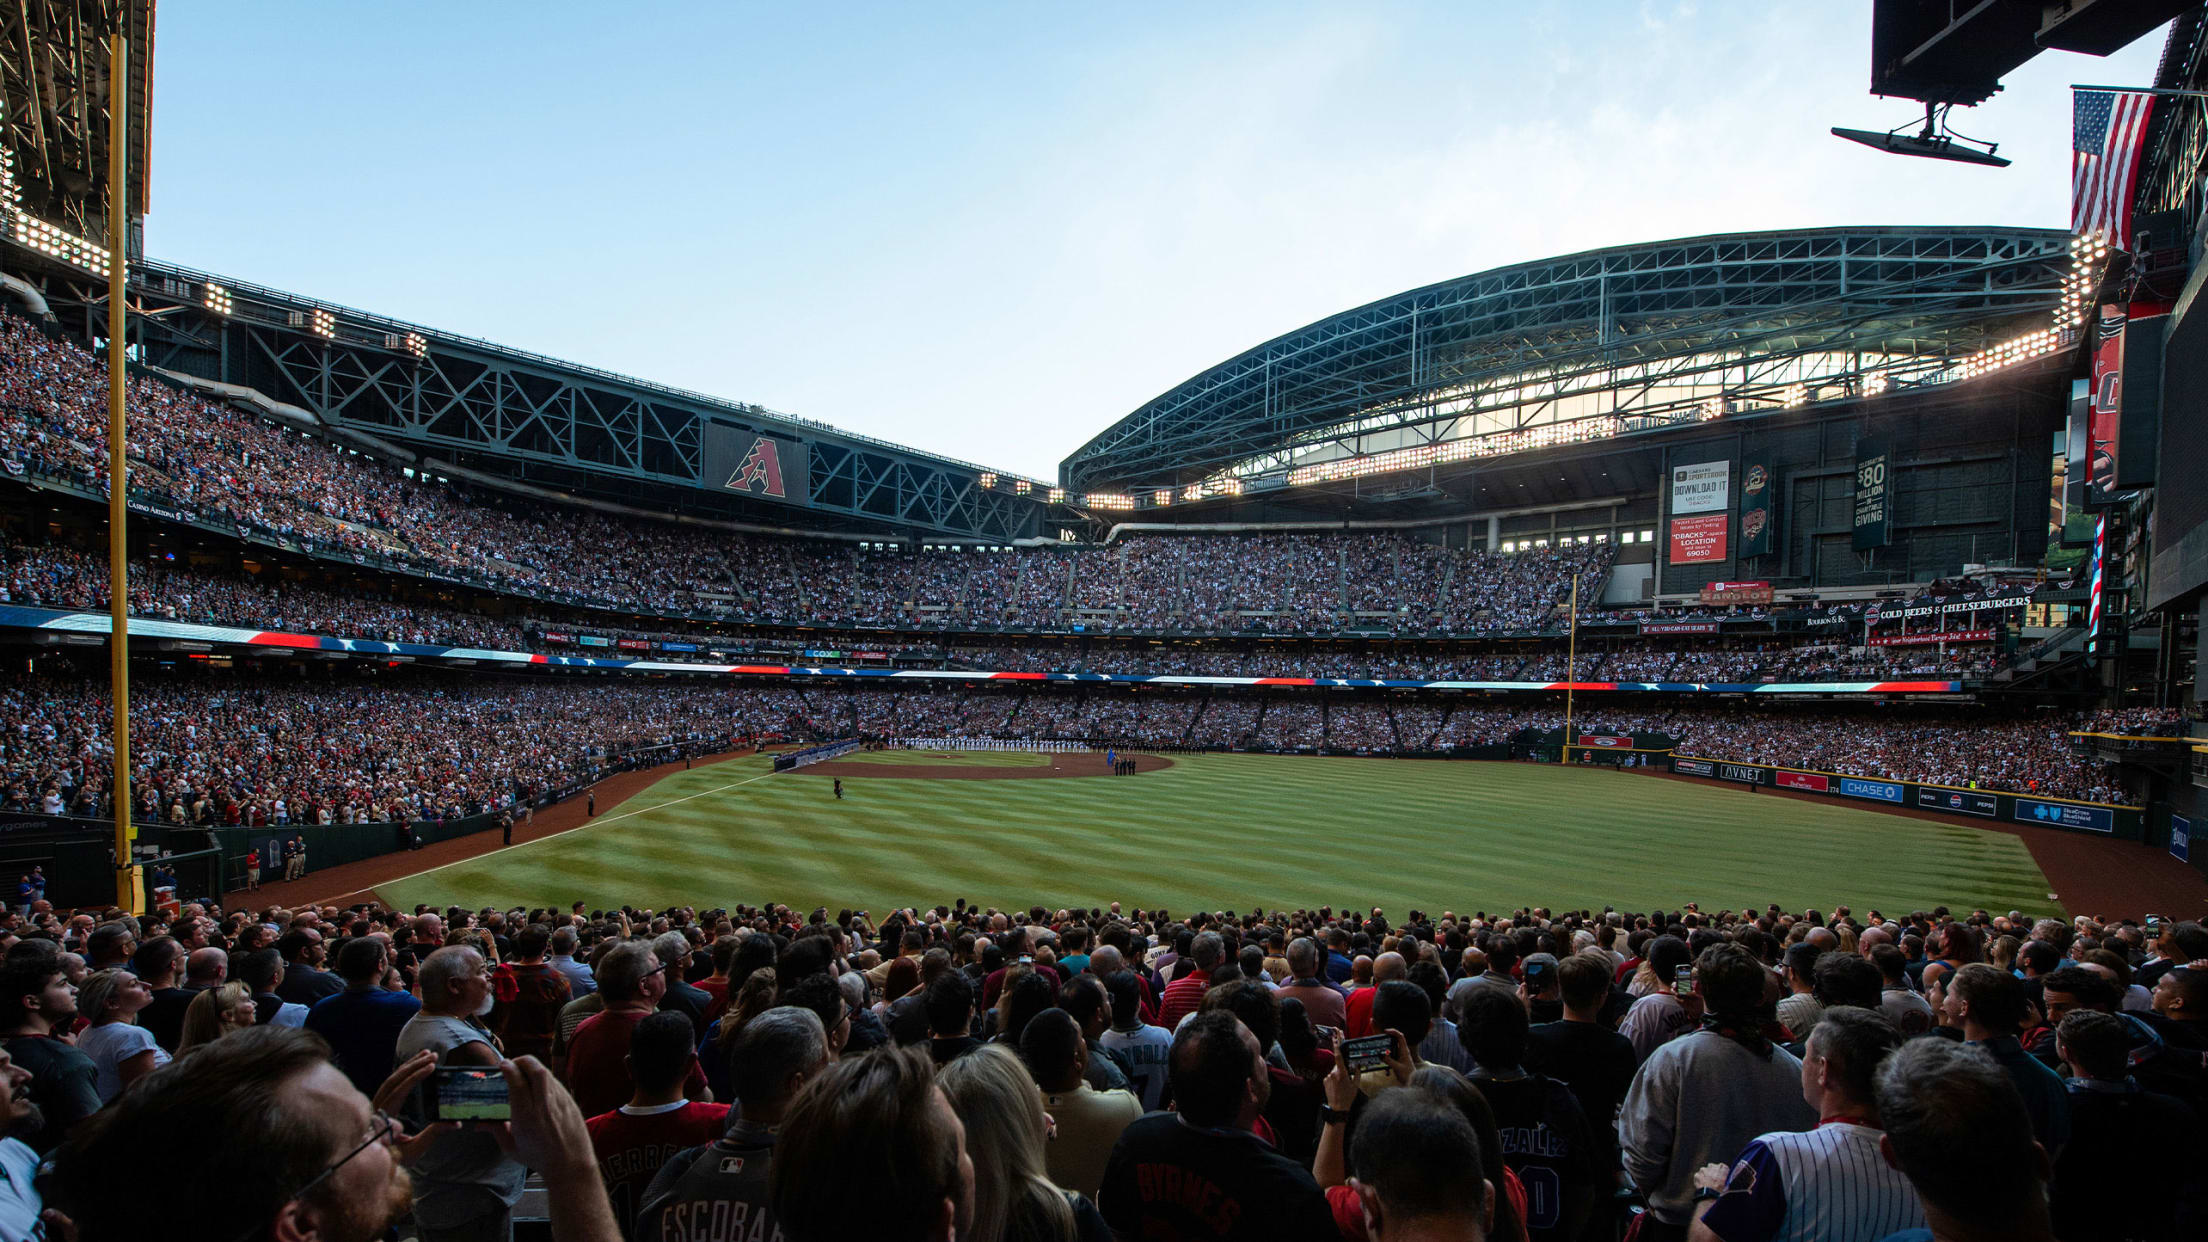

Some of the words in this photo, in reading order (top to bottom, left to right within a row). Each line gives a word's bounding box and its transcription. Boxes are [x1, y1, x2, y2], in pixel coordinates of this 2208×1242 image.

[1858, 463, 1885, 488] $80
[1675, 482, 1717, 496] DOWNLOAD
[1719, 480, 1727, 491] IT
[1856, 484, 1884, 500] MILLION
[1855, 510, 1883, 527] GIVING
[1680, 538, 1717, 546] LOCATION
[1702, 591, 1769, 601] SANDLOT
[1880, 609, 1903, 619] COLD
[1904, 606, 1933, 617] BEERS
[1934, 606, 1940, 614] &
[1942, 596, 2031, 613] CHEESEBURGERS
[813, 650, 833, 658] COX
[1725, 766, 1760, 781] AVNET
[1847, 782, 1883, 796] CHASE
